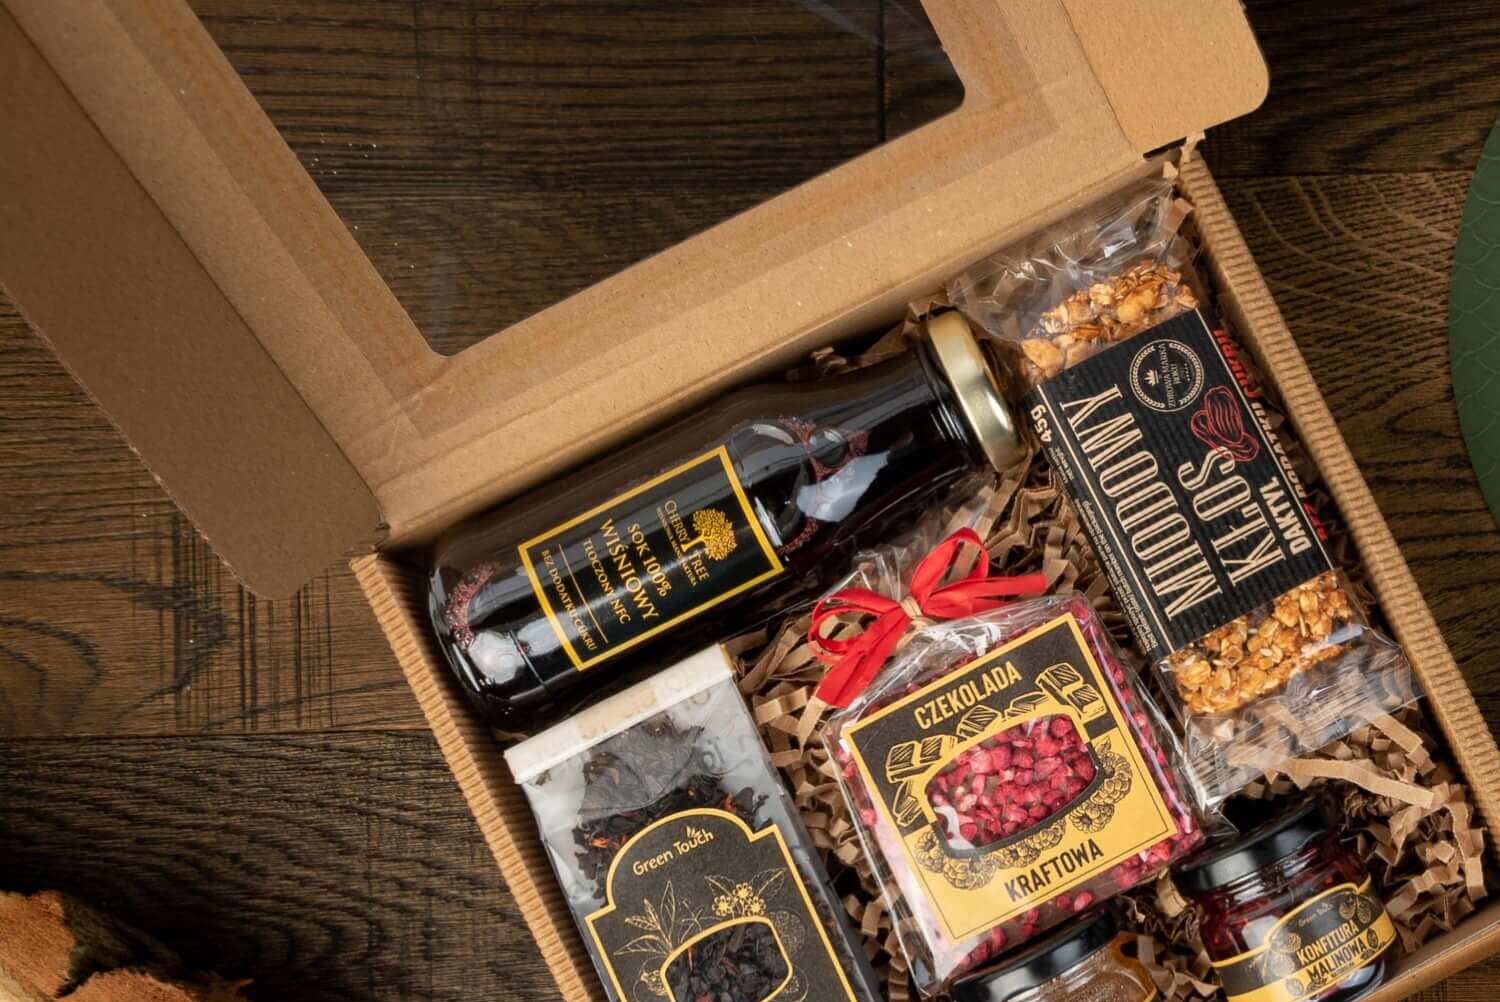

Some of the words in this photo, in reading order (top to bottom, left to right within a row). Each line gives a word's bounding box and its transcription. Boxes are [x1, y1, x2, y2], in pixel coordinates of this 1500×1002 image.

[1026, 402, 1055, 444] 45g
[661, 498, 691, 543] CHERRY
[687, 550, 710, 581] TREE
[1058, 384, 1223, 620] MIODOWY
[1173, 446, 1288, 586] KŁOS
[1256, 474, 1313, 556] DAKTYL
[579, 536, 619, 600] TŁOCZONY
[609, 596, 631, 625] NFC
[595, 516, 660, 622] WIŚNIOWY
[625, 521, 651, 556] SOK
[642, 555, 673, 598] 100%
[539, 549, 555, 567] BEZ
[547, 567, 580, 618] DODATKU
[572, 617, 597, 652] CUKRU
[912, 658, 1023, 731] CZEKOLADA
[631, 849, 674, 877] Green
[672, 826, 714, 857] Touch
[1003, 836, 1104, 903] KRAFTOWA
[1295, 917, 1360, 966] KONFITURA
[1305, 935, 1368, 982] MALINOWA
